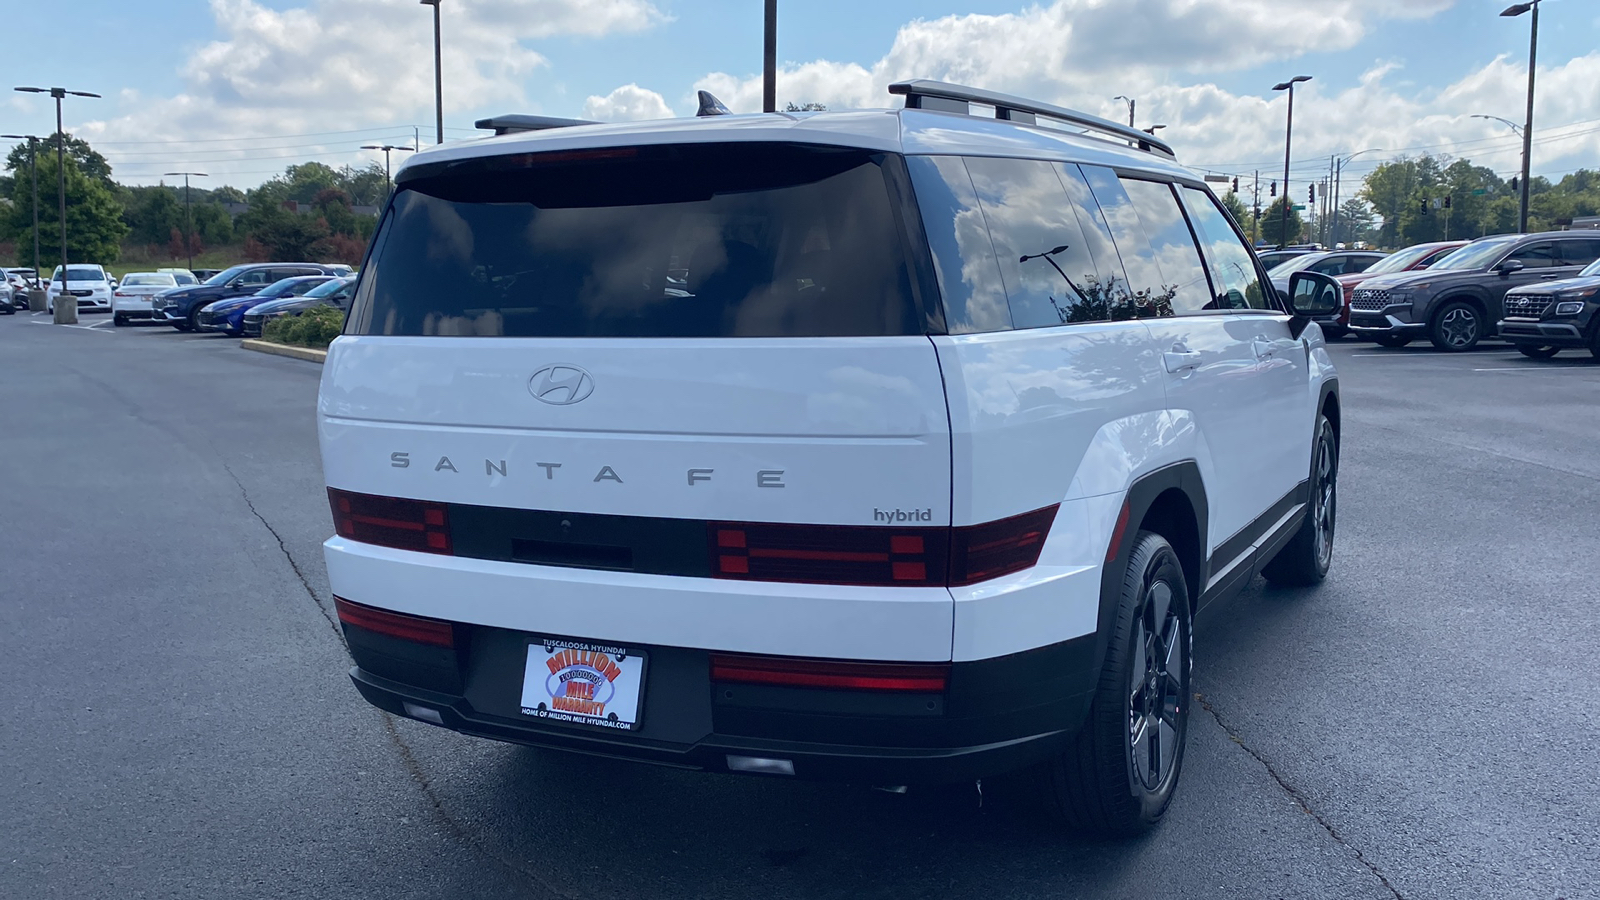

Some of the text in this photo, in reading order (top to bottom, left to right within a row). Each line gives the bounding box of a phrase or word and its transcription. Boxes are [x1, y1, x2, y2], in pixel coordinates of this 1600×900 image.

[390, 451, 786, 488] SANTA FE
[873, 507, 932, 524] hybrid
[543, 639, 626, 655] TUSCALOOSA HYUNDAI
[546, 648, 621, 683] MILLION
[566, 681, 594, 700] MILE
[552, 696, 605, 716] WARRANTY
[521, 708, 631, 730] HOME OF MILLION MILE HYUNDAI.COM
